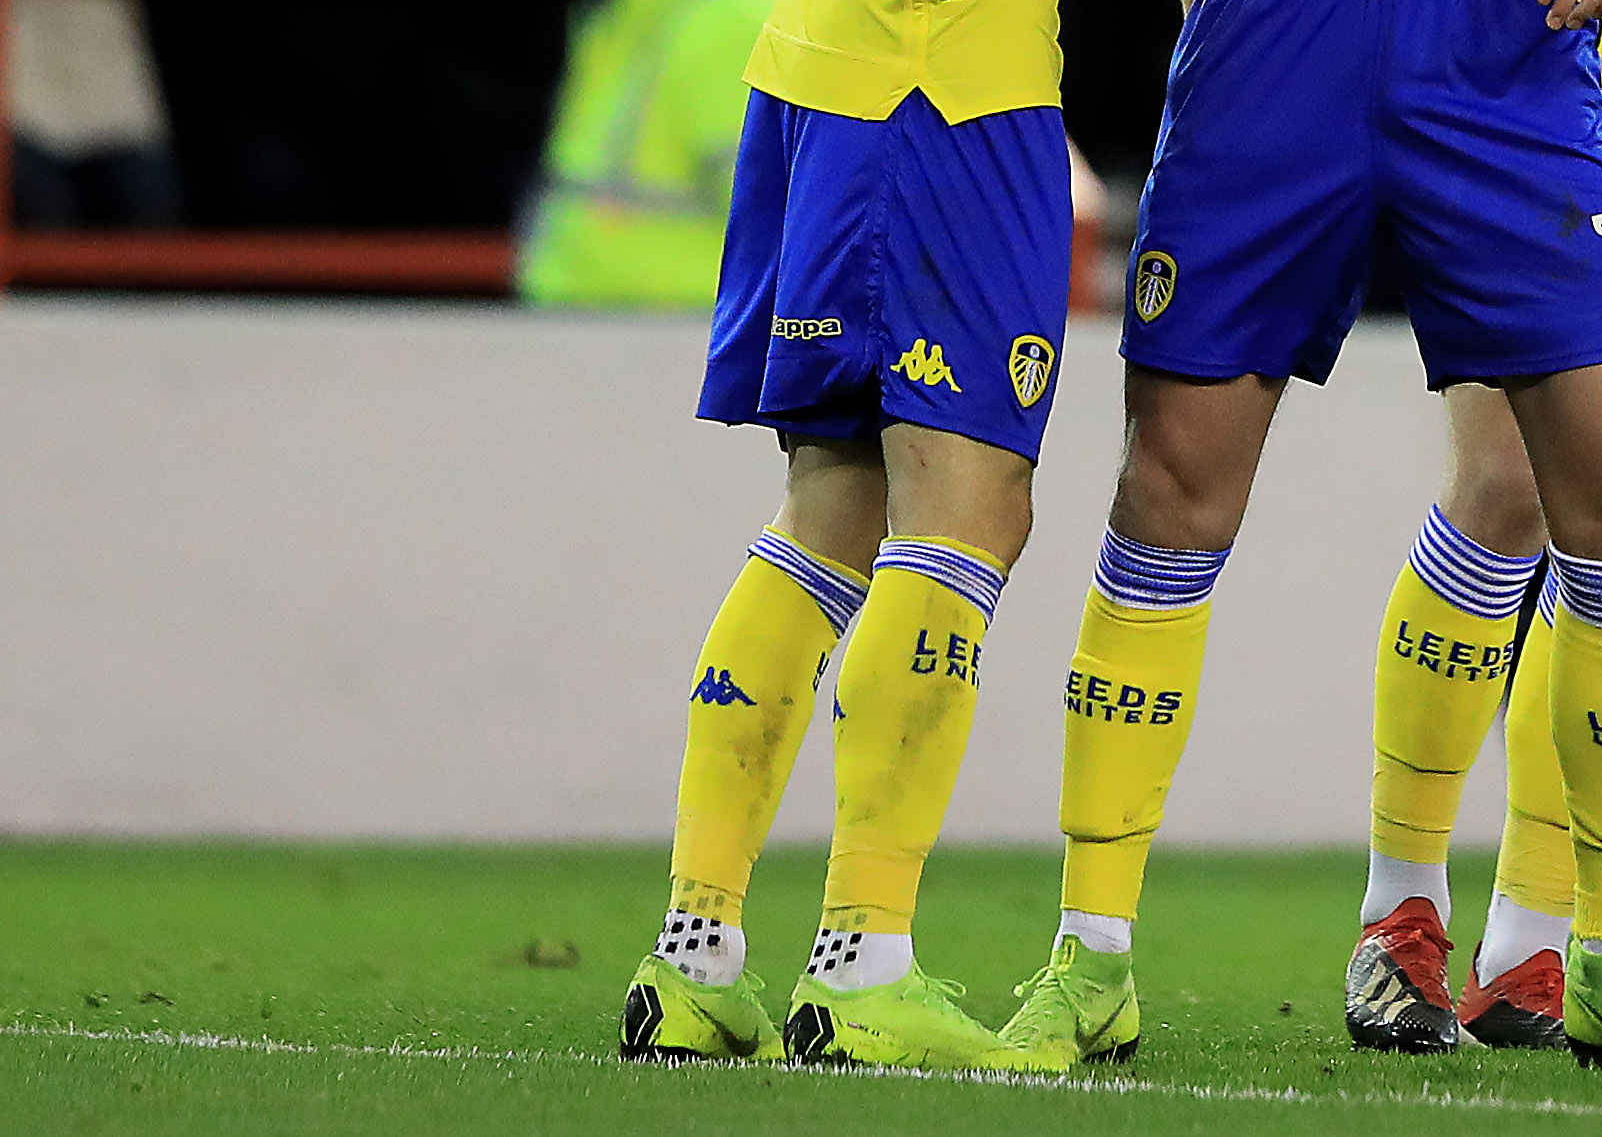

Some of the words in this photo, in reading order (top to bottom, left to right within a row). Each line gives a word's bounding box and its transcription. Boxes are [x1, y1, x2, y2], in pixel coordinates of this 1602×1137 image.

[771, 315, 843, 340] appa
[916, 629, 982, 669] LEE
[1066, 670, 1183, 711] EEDS
[1064, 693, 1174, 724] NITED
